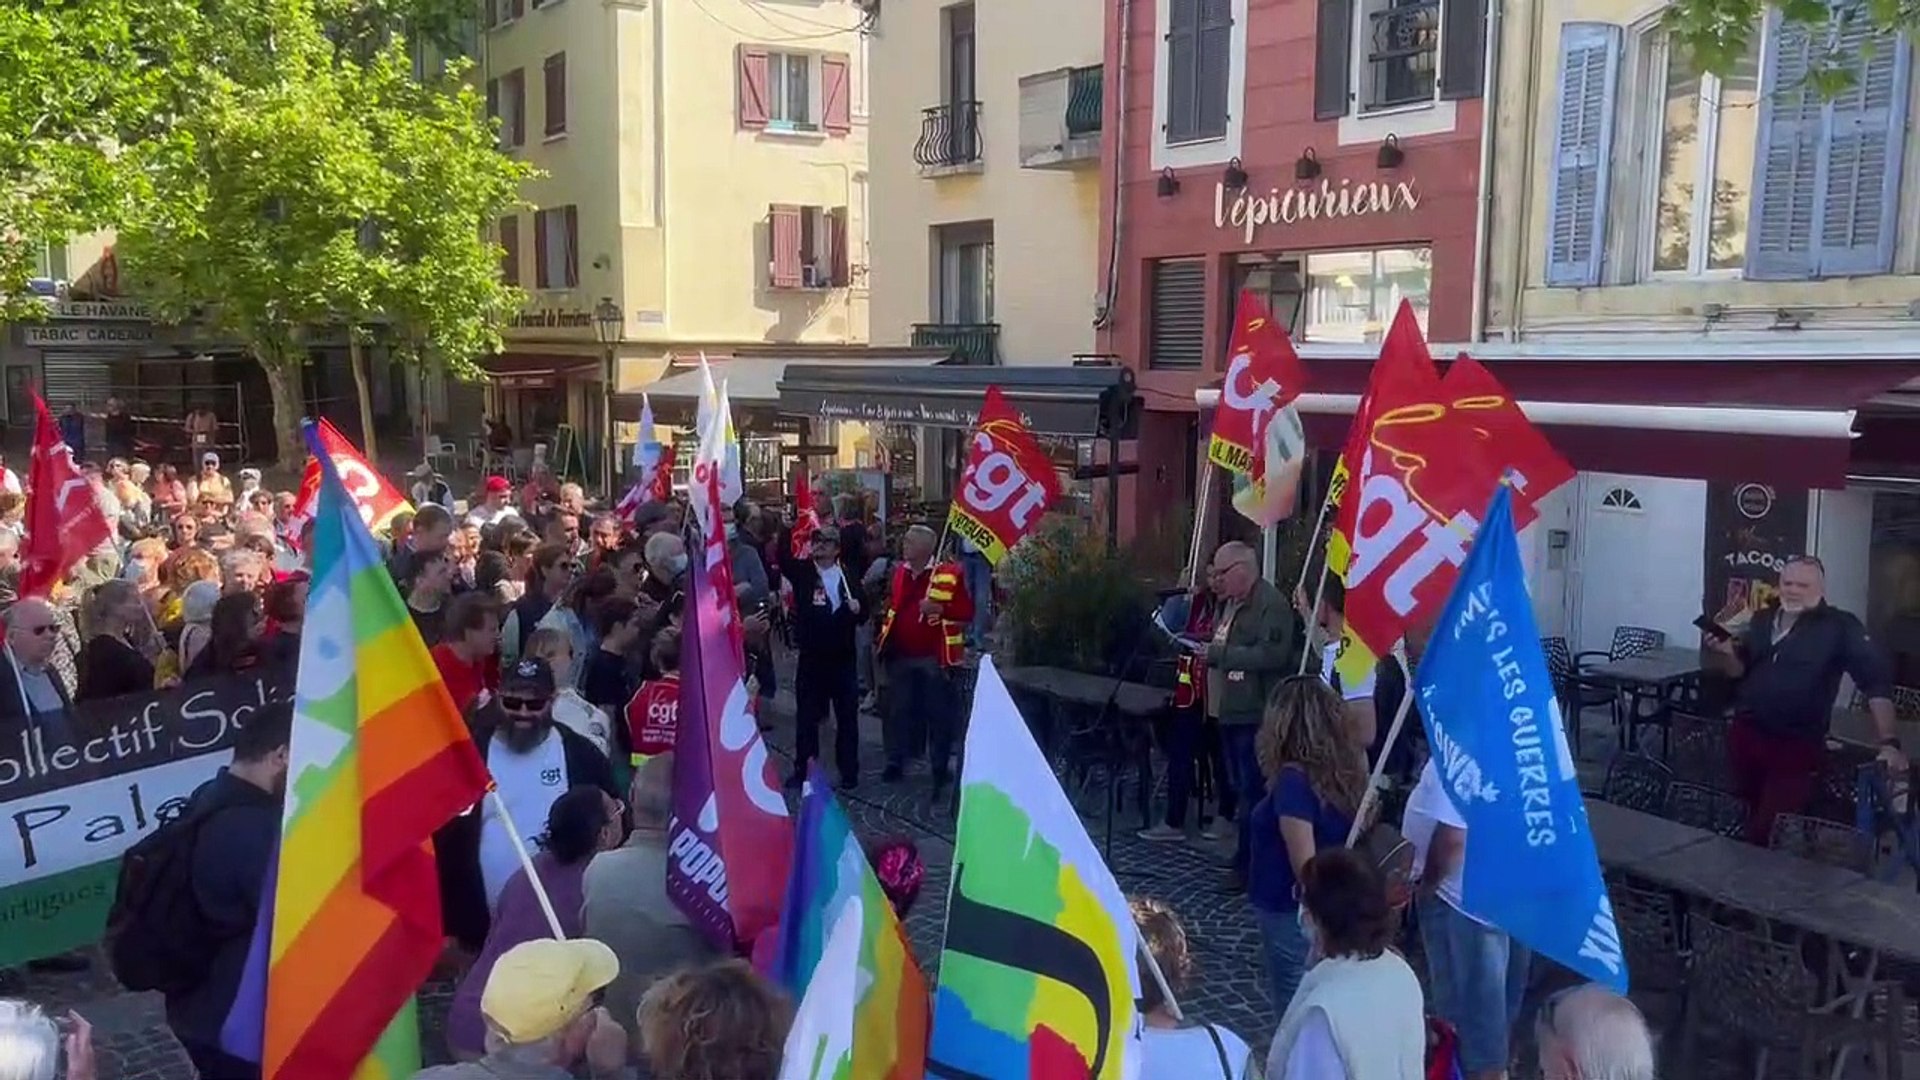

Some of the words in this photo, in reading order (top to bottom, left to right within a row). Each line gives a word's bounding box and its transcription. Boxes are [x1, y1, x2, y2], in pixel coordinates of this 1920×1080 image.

[61, 304, 82, 316] LE
[86, 304, 149, 317] HAVANE
[31, 328, 79, 341] TABAC
[1725, 550, 1785, 572] TACOS
[1491, 646, 1526, 700] LES
[649, 700, 678, 724] cgt
[0, 701, 163, 785] ollectif
[1508, 704, 1557, 847] GUERRES
